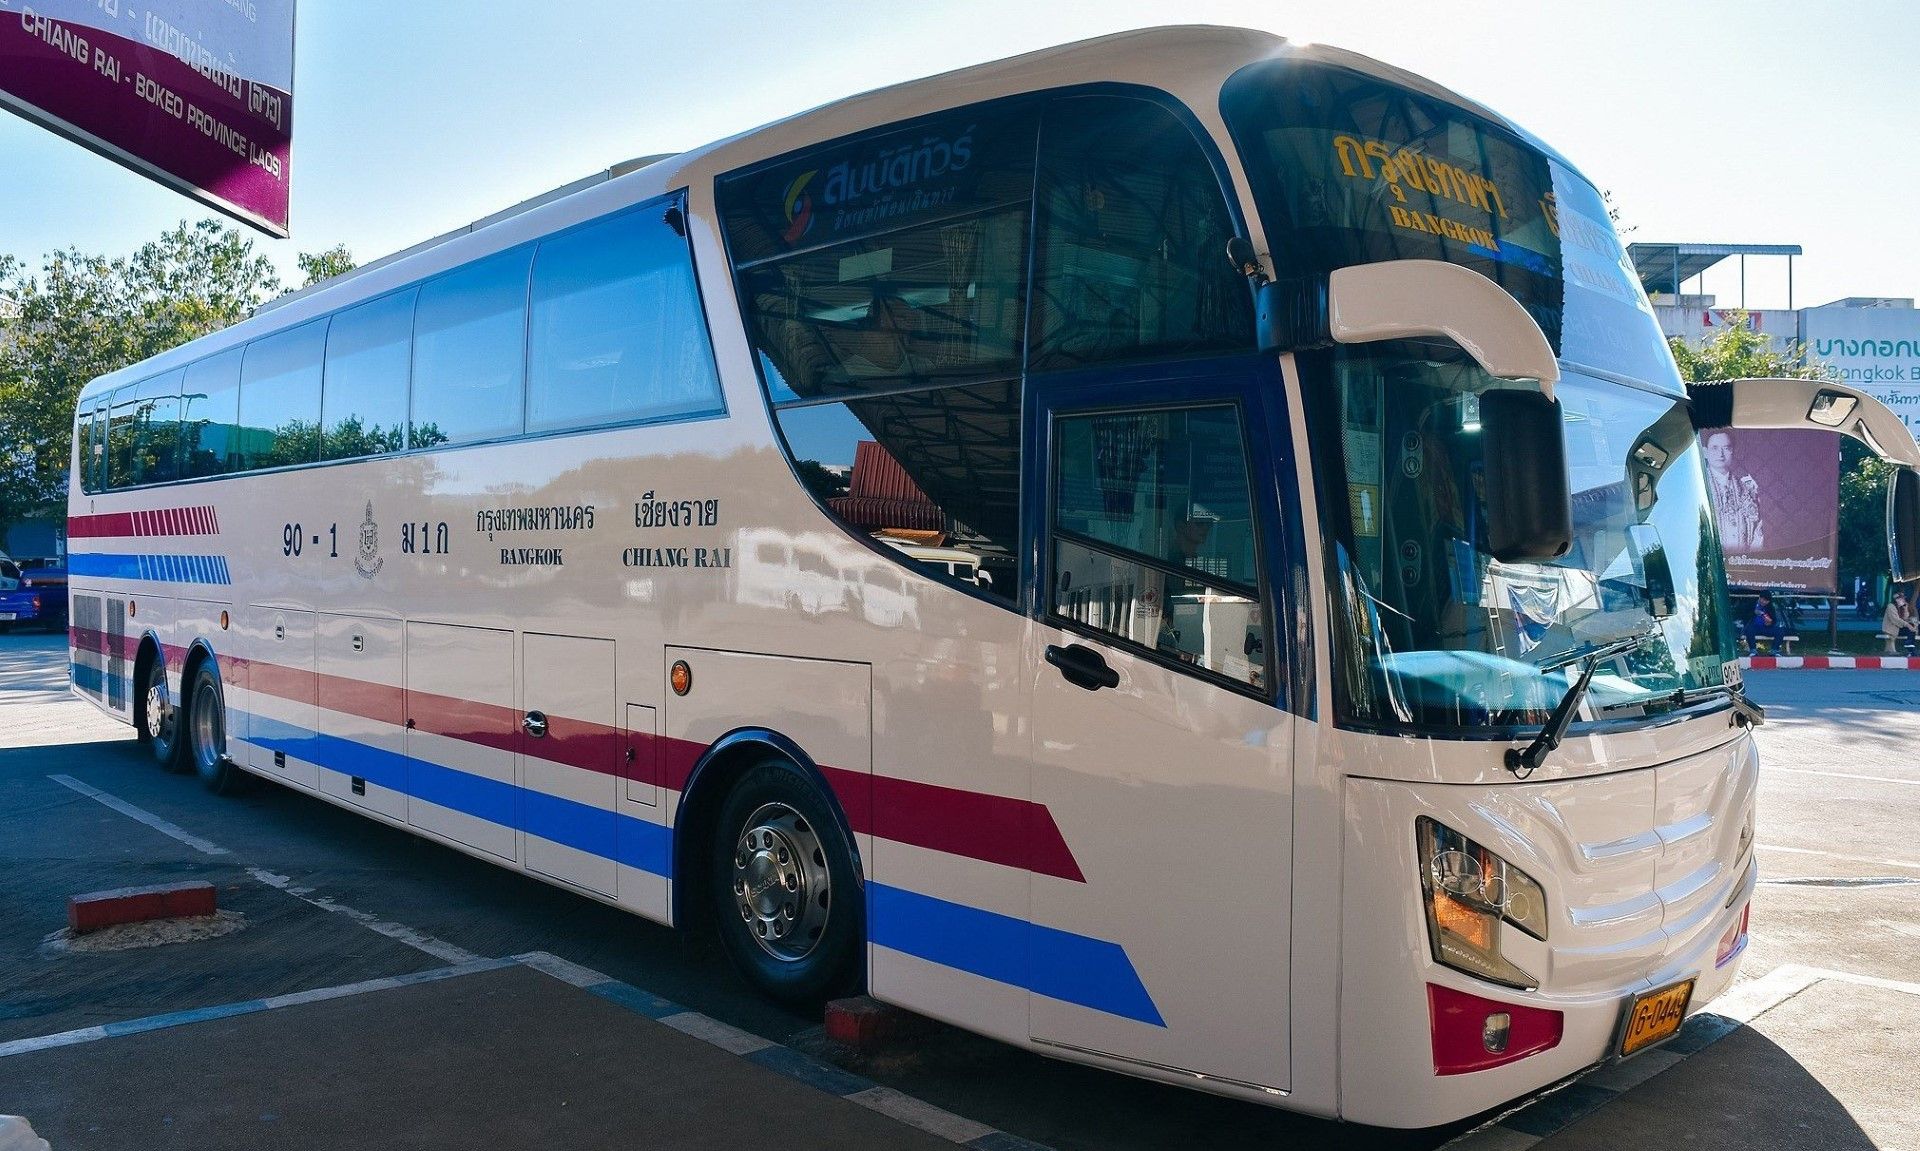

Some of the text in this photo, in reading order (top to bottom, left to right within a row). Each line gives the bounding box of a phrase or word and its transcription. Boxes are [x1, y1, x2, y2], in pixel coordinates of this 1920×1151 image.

[21, 5, 89, 65] CHIANG
[93, 46, 121, 84] RAI
[135, 71, 184, 120] BOKEO
[187, 103, 248, 157] PROVINCE
[249, 141, 283, 182] (LAOS)
[248, 80, 282, 131] (ลาว)
[1389, 205, 1501, 252] BANGKOK
[1828, 365, 1905, 383] Bangkok
[476, 505, 595, 542] กรุงเทพมหานคร
[634, 490, 718, 528] เชียงราย
[283, 523, 302, 557] 90
[329, 523, 338, 558] 1
[500, 548, 564, 566] BANGKOK
[622, 547, 731, 568] CHIANG RAI
